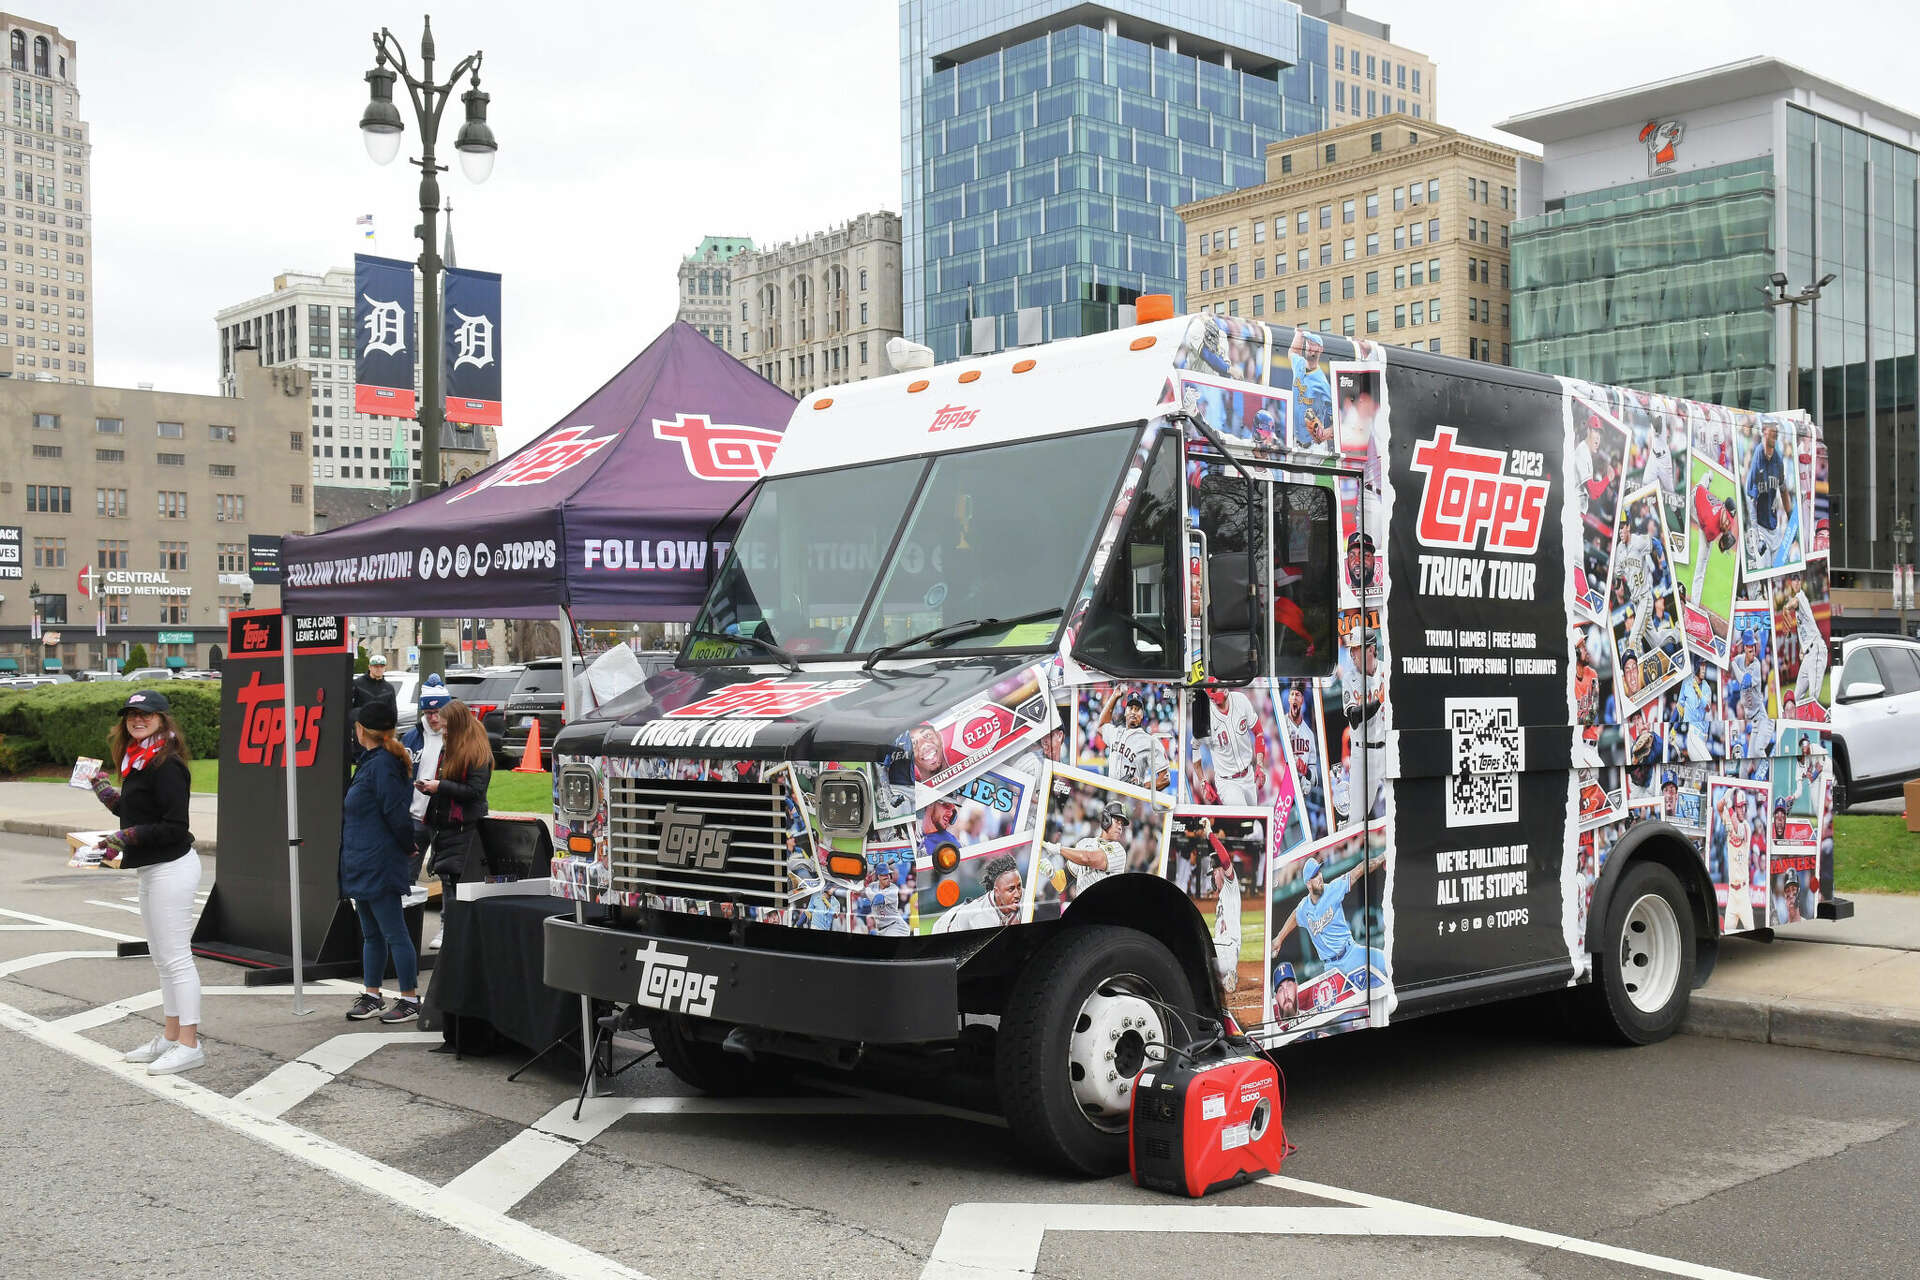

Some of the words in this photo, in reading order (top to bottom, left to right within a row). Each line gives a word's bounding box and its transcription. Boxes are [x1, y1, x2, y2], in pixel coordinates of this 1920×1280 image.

[928, 404, 981, 432] Topps
[1511, 450, 1544, 477] 2023
[1410, 425, 1551, 556] Topps
[494, 539, 556, 572] @TOPPS
[584, 539, 708, 570] FOLLOW
[106, 571, 170, 584] CENTRAL
[288, 563, 335, 588] FOLLOW
[335, 558, 358, 585] THE
[357, 551, 413, 581] ACTION!
[1418, 554, 1485, 598] TRUCK
[1488, 560, 1537, 601] TOUR
[134, 586, 192, 596] METHODIST
[243, 620, 270, 649] Topps
[296, 617, 311, 629] TAKE
[312, 617, 318, 628] A
[318, 616, 337, 629] CARD,
[296, 630, 314, 642] LEAVE
[314, 630, 319, 640] A
[320, 629, 337, 641] CARD
[1425, 629, 1453, 647] TRIVIA
[1459, 631, 1487, 648] GAMES
[1492, 632, 1511, 648] FREE
[1511, 632, 1537, 649] CARDS
[1402, 657, 1429, 674] TRADE
[1429, 657, 1452, 674] WALL
[1459, 658, 1484, 674] TOPPS
[1484, 658, 1507, 674] SWAG
[1515, 659, 1557, 675] GIVEAWAYS
[631, 719, 711, 747] TRUCK
[699, 719, 774, 748] TOUR
[964, 716, 1001, 746] REDS
[931, 764, 963, 786] HUNTER
[963, 747, 995, 768] GREENE
[1478, 752, 1501, 771] Topps
[655, 802, 733, 873] Topps
[1436, 851, 1468, 873] WE'RE
[1469, 847, 1509, 870] PULLING
[1510, 844, 1529, 865] OUT
[1437, 879, 1460, 905] ALL
[1460, 876, 1484, 901] THE
[1486, 871, 1528, 899] STOPS!
[1487, 908, 1529, 929] @TOPPS
[635, 940, 719, 1017] Topps
[1241, 1092, 1260, 1103] 2000
